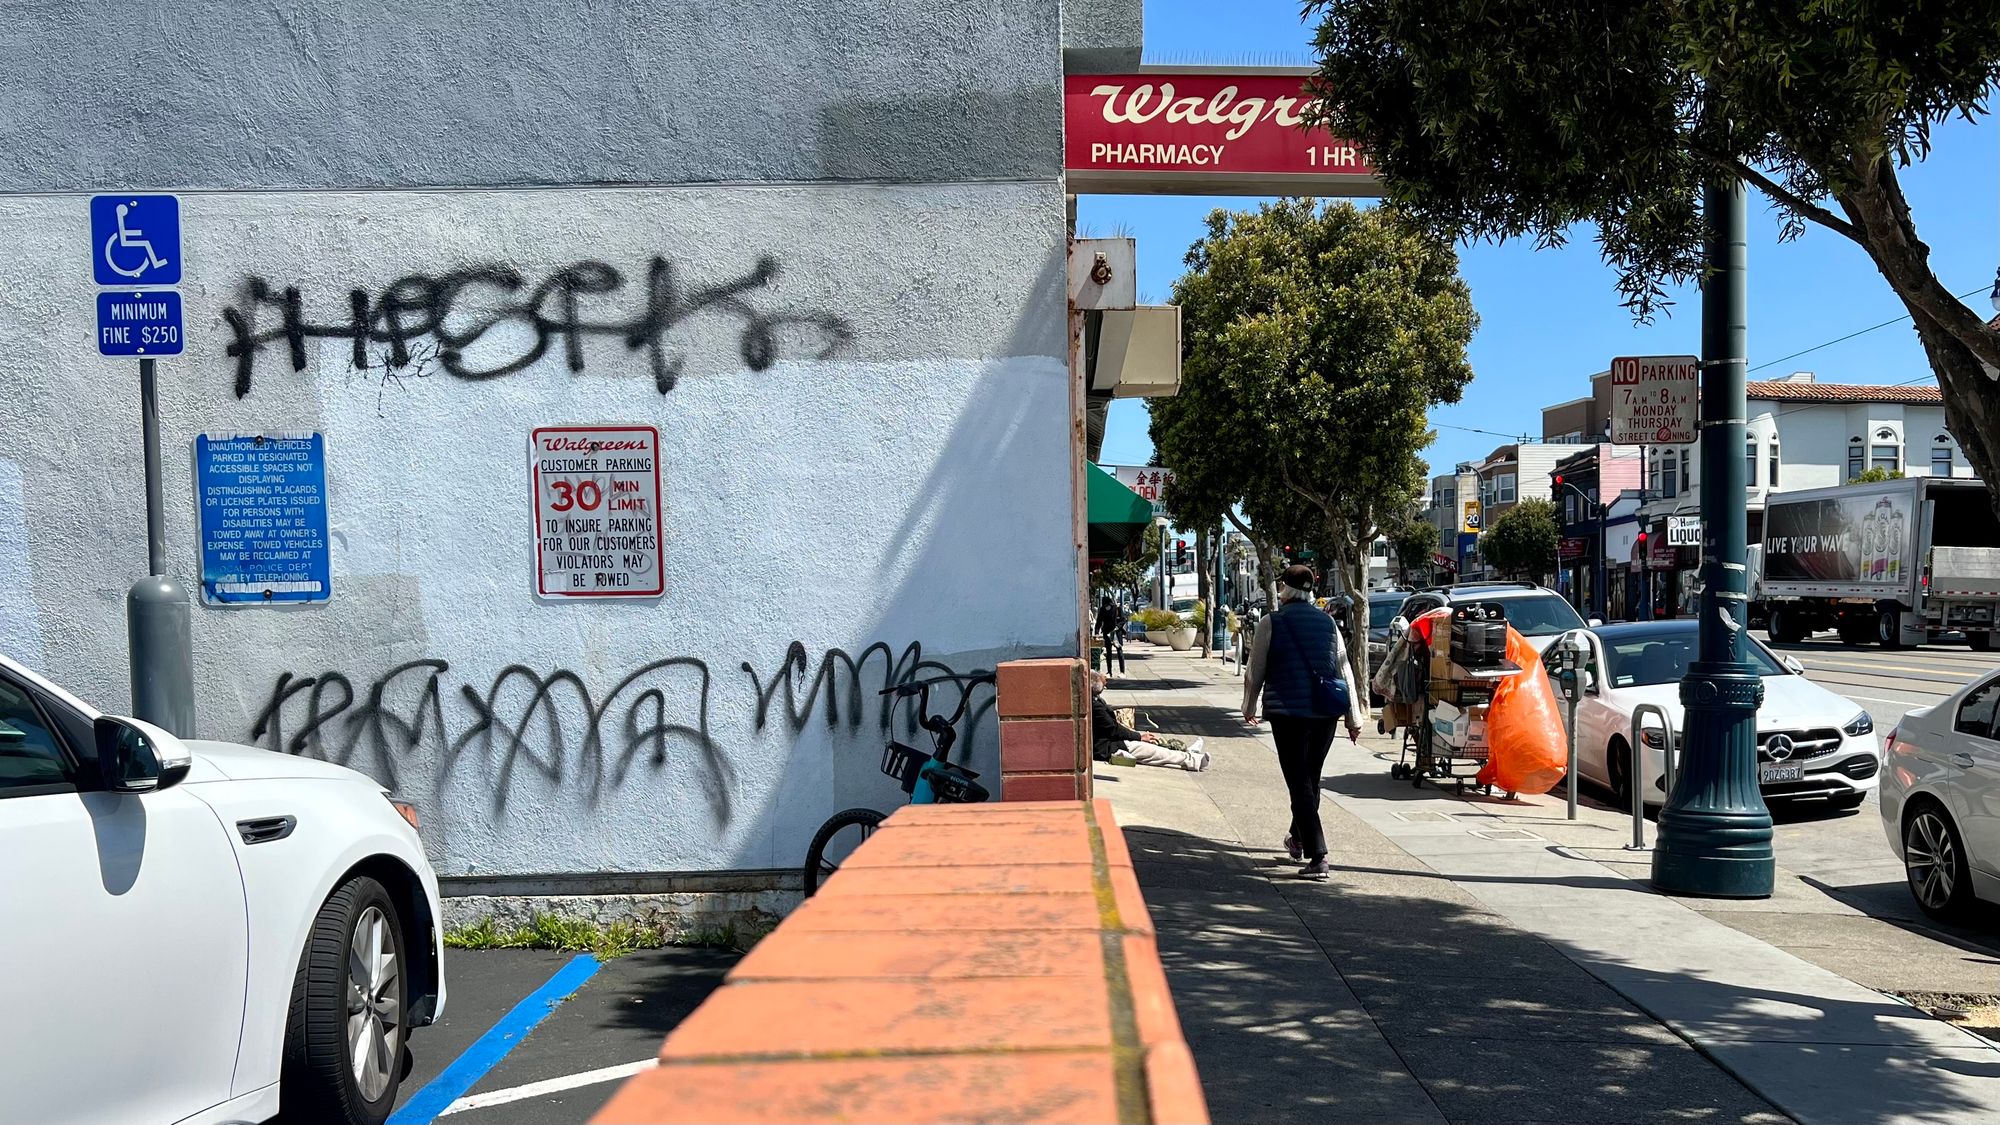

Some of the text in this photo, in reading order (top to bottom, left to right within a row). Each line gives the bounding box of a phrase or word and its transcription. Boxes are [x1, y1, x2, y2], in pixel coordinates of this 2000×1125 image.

[1091, 143, 1224, 164] PHARMACY
[1306, 145, 1316, 166] 1
[1323, 145, 1356, 167] HR
[111, 303, 167, 320] MINIMUM
[103, 325, 177, 345] FINE $250
[1614, 360, 1695, 382] NO PARKING
[1633, 405, 1677, 416] MONDAY
[1628, 417, 1682, 429] THURSDAY
[1618, 431, 1690, 441] STREET CNING
[208, 441, 312, 451] UNAUTHORIZED VEHICLES
[543, 437, 648, 455] Walgreens
[212, 452, 308, 462] PARKED IN DESIGNATED
[209, 463, 312, 473] ACCESSIBLE SPACES NOT
[541, 458, 651, 471] CUSTOMER PARKING
[239, 475, 285, 484] DISPLAYING
[207, 485, 317, 495] DISTINGUISHING PLACARDS
[551, 480, 639, 511] 30 MIN
[206, 496, 320, 506] OR LICENSE PLATES ISSUED
[608, 498, 645, 511] LIMIT
[223, 507, 304, 517] FOR PERSONS WITH
[223, 518, 306, 528] DISABILITIES MAY BE
[1466, 514, 1479, 524] 20
[546, 518, 652, 533] TO INSURE PARKING
[212, 529, 317, 539] TOWED AWAY AT OWNER'S
[1670, 529, 1701, 544] LIQUO
[253, 540, 281, 549] TOWED
[284, 539, 323, 548] VEHICLES
[543, 536, 656, 551] FOR OUR CUSTOMERS
[1767, 537, 1788, 554] LIVE
[1820, 532, 1850, 552] WAVE
[220, 550, 311, 560] MAY BE RECLAIMED AT
[556, 554, 644, 569] VIOLATORS MAY
[249, 563, 283, 572] POLICE
[573, 572, 630, 587] BE TOWED
